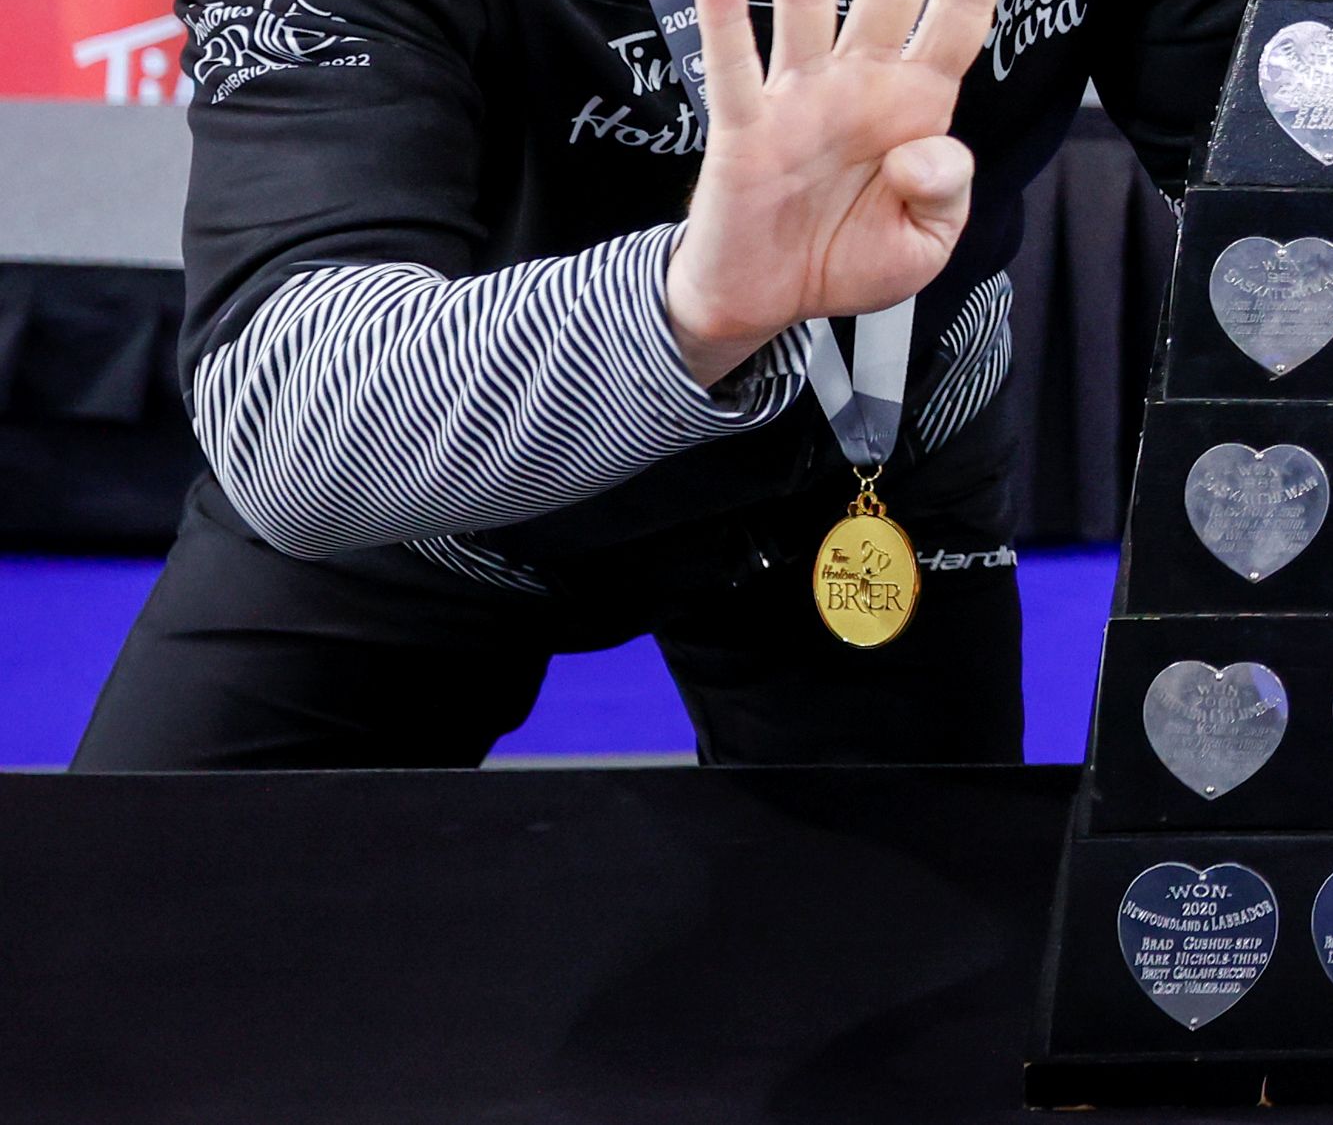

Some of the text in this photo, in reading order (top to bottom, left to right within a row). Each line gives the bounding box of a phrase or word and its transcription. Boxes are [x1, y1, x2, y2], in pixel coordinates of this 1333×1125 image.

[661, 6, 698, 35] 202
[826, 578, 905, 618] BRIER
[1122, 900, 1201, 932] NEWFOUNDLAND
[1211, 900, 1274, 932] LABRADOR
[1182, 902, 1217, 917] 2020
[1141, 936, 1175, 951] BRAD
[1134, 951, 1171, 966] MARK
